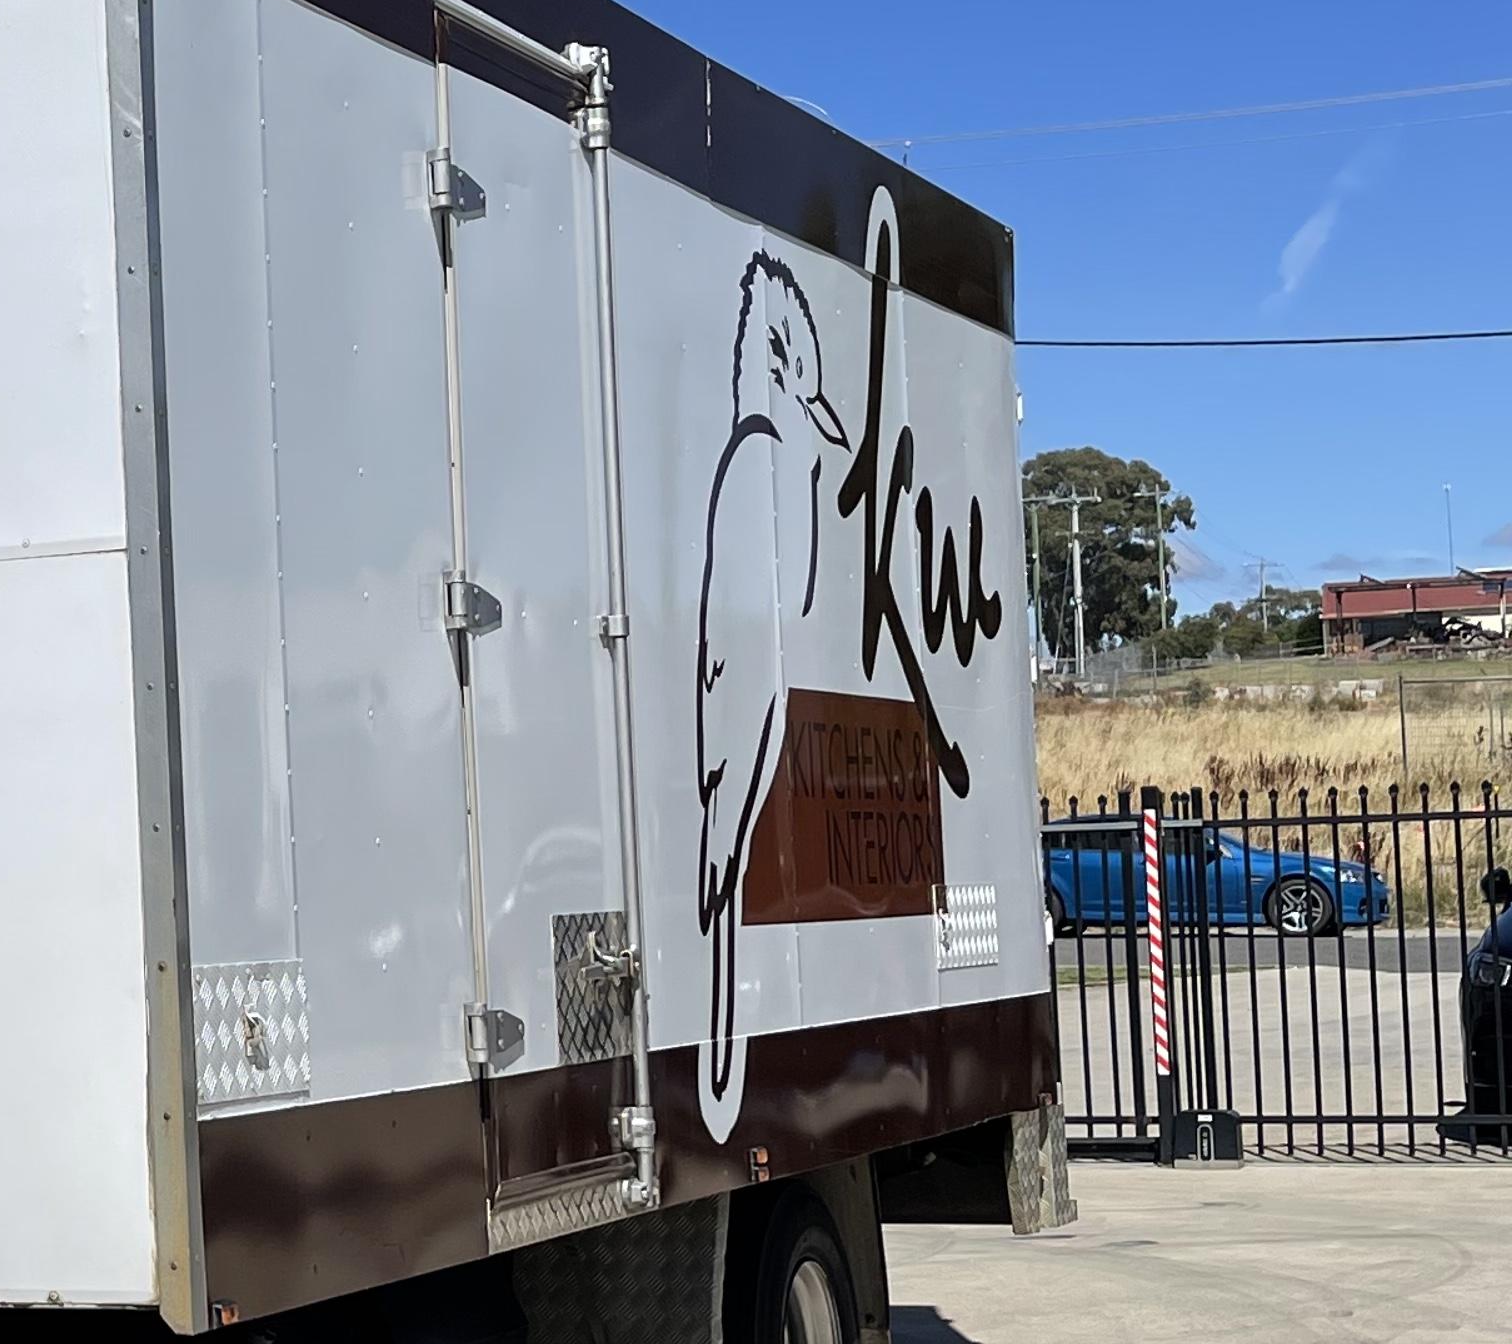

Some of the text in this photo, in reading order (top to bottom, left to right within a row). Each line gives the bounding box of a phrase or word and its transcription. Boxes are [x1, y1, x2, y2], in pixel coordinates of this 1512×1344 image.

[837, 219, 1002, 799] kw
[790, 720, 930, 803] KITCHENS &
[825, 808, 936, 886] INTERIORS
